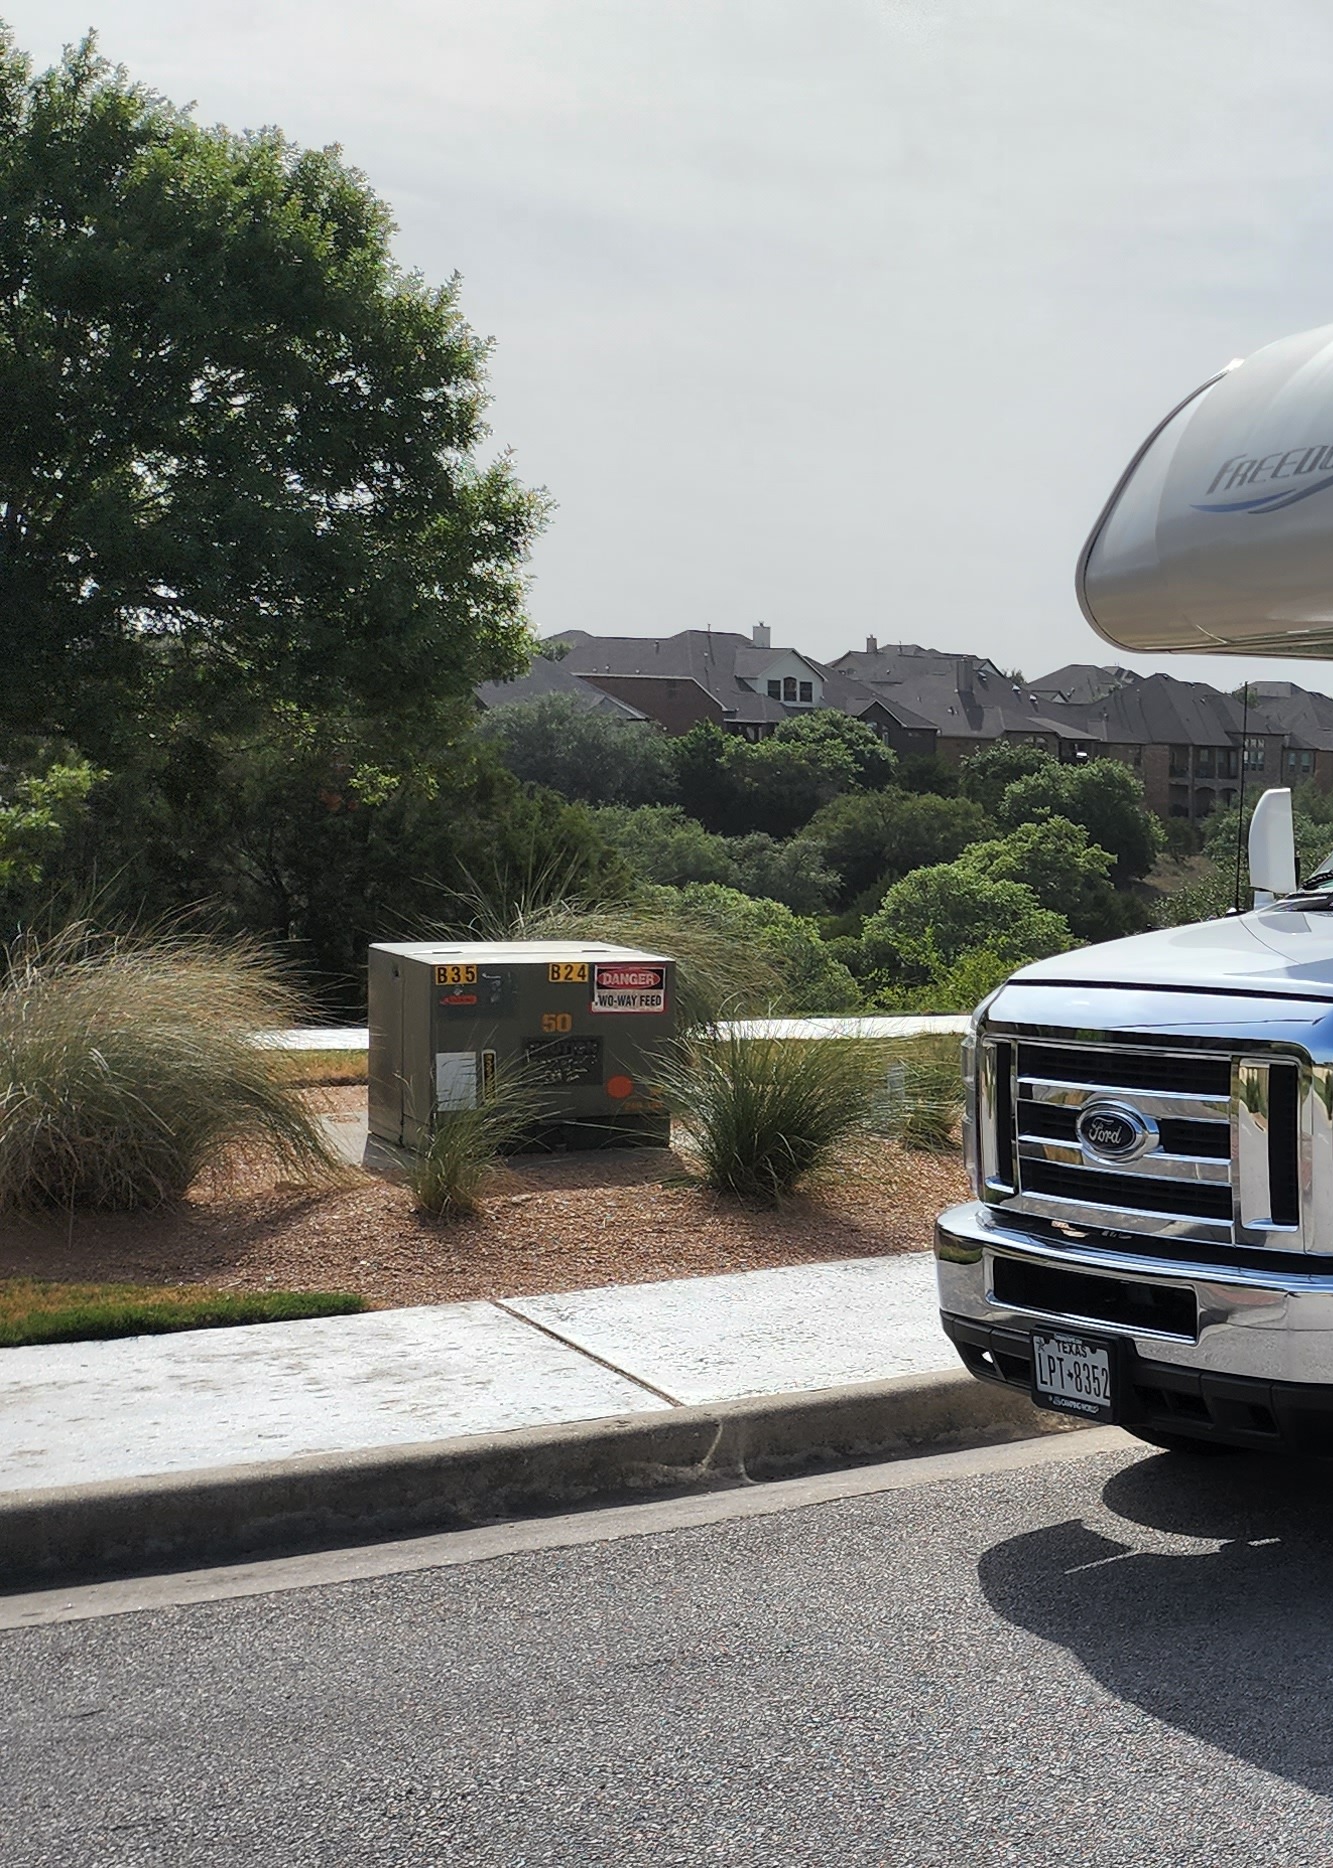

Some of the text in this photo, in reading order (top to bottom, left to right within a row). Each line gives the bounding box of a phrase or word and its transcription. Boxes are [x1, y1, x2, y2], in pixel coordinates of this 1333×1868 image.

[602, 972, 655, 985] DANGER
[640, 994, 662, 1007] FEED
[541, 1013, 573, 1033] 50
[1088, 1116, 1123, 1144] Ford
[1055, 1340, 1088, 1359] TEXAS
